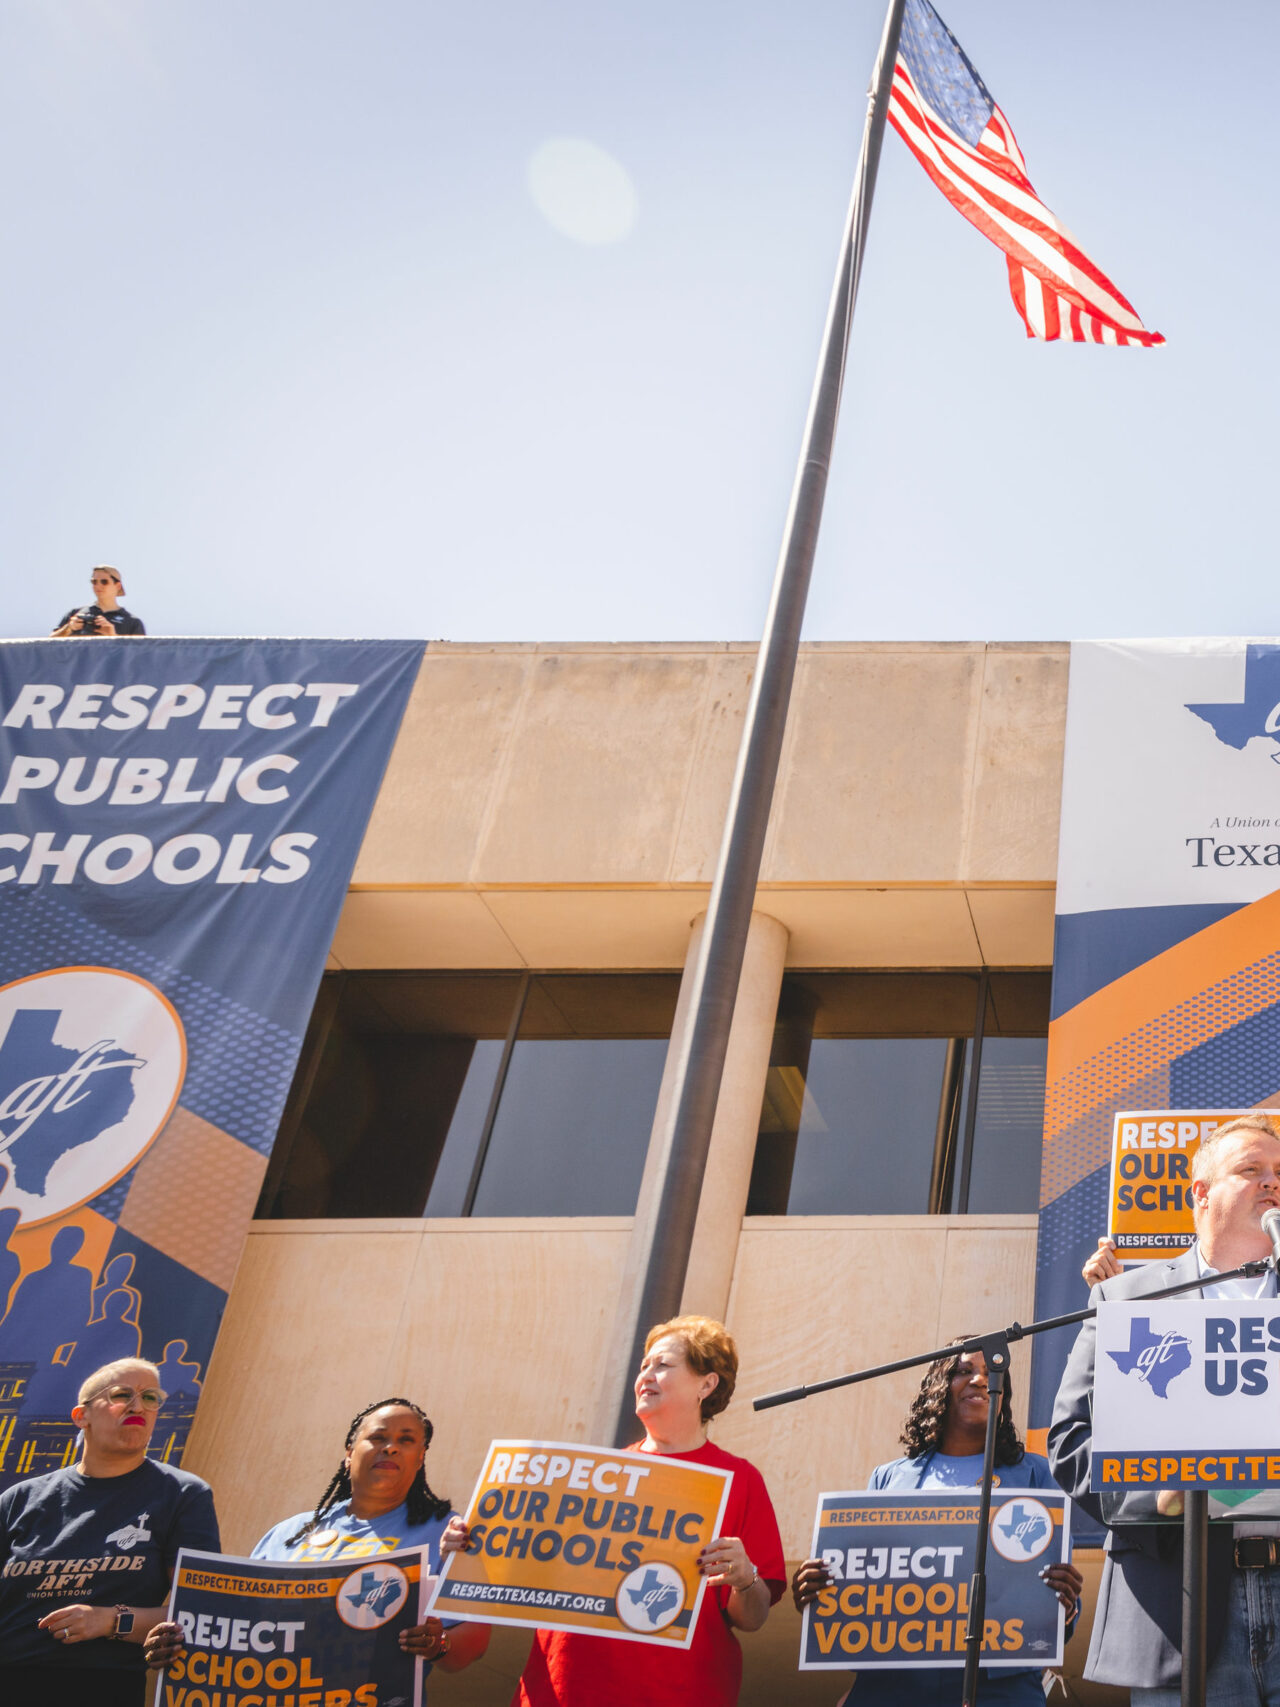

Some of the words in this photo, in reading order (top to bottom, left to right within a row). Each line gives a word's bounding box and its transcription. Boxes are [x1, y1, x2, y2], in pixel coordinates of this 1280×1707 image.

[2, 683, 359, 730] RESPECT
[0, 755, 299, 805] PUBLIC
[1210, 817, 1220, 828] A
[1226, 817, 1270, 828] Union
[1119, 1153, 1189, 1180] OUR
[1118, 1235, 1196, 1246] RESPECT.TEX
[1136, 1330, 1192, 1382] aft
[1204, 1358, 1269, 1397] US
[487, 1452, 650, 1497] RESPECT
[477, 1488, 550, 1522] OUR
[554, 1493, 704, 1544] PUBLIC
[465, 1524, 645, 1574] SCHOOLS
[822, 1546, 963, 1580] REJECT
[1, 1556, 146, 1579] NORTHSIDE
[36, 1573, 94, 1590] AFT
[185, 1572, 328, 1595] RESPECT.TEXASAFT.ORG
[57, 1588, 93, 1597] STRONG
[450, 1583, 606, 1612] RESPECT.TEXASAFT.ORG
[178, 1610, 305, 1653] REJECT
[168, 1649, 323, 1690] SCHOOL
